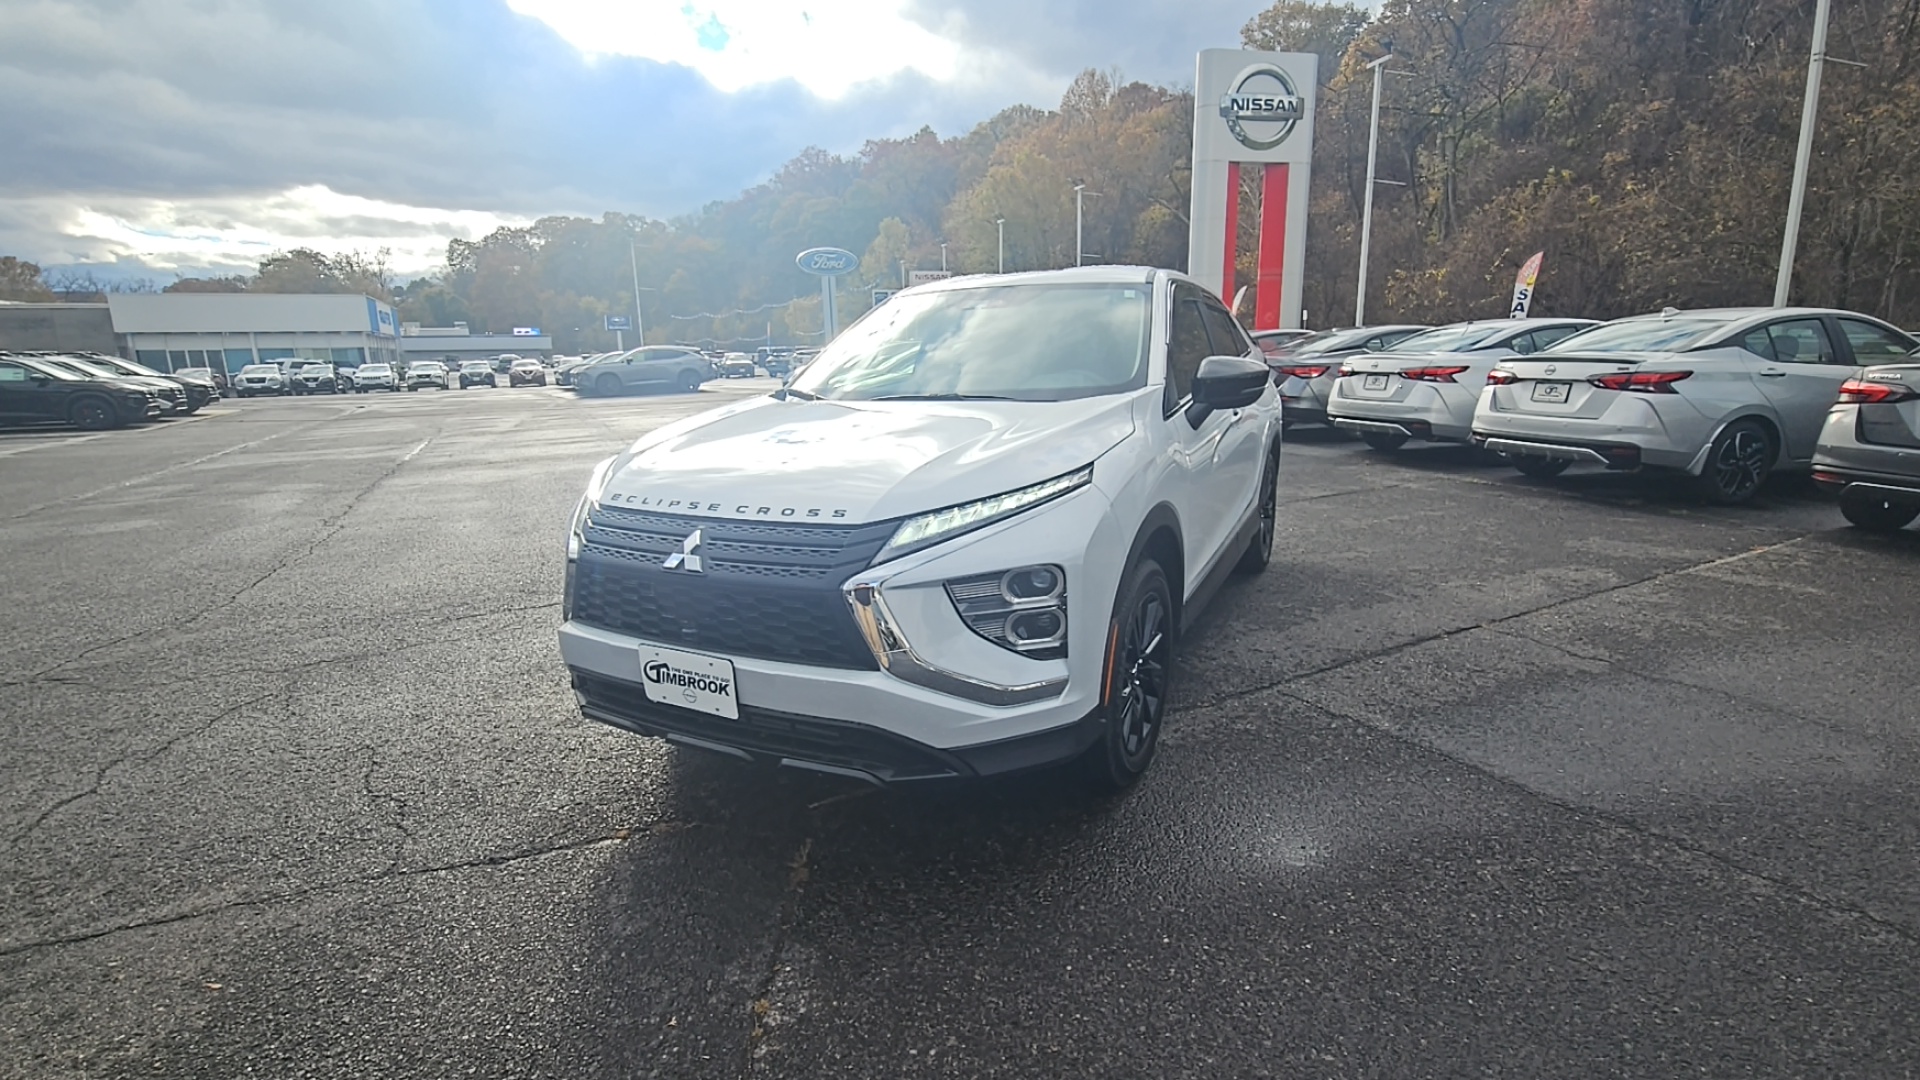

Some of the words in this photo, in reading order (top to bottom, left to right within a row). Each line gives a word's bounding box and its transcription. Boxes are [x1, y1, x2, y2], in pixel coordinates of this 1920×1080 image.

[1231, 98, 1298, 112] NISSAN
[811, 253, 846, 269] Ford
[1511, 288, 1529, 318] SA
[610, 493, 721, 512] ECLIPSE
[736, 505, 848, 518] CROSS
[644, 660, 730, 697] TIMBROOK
